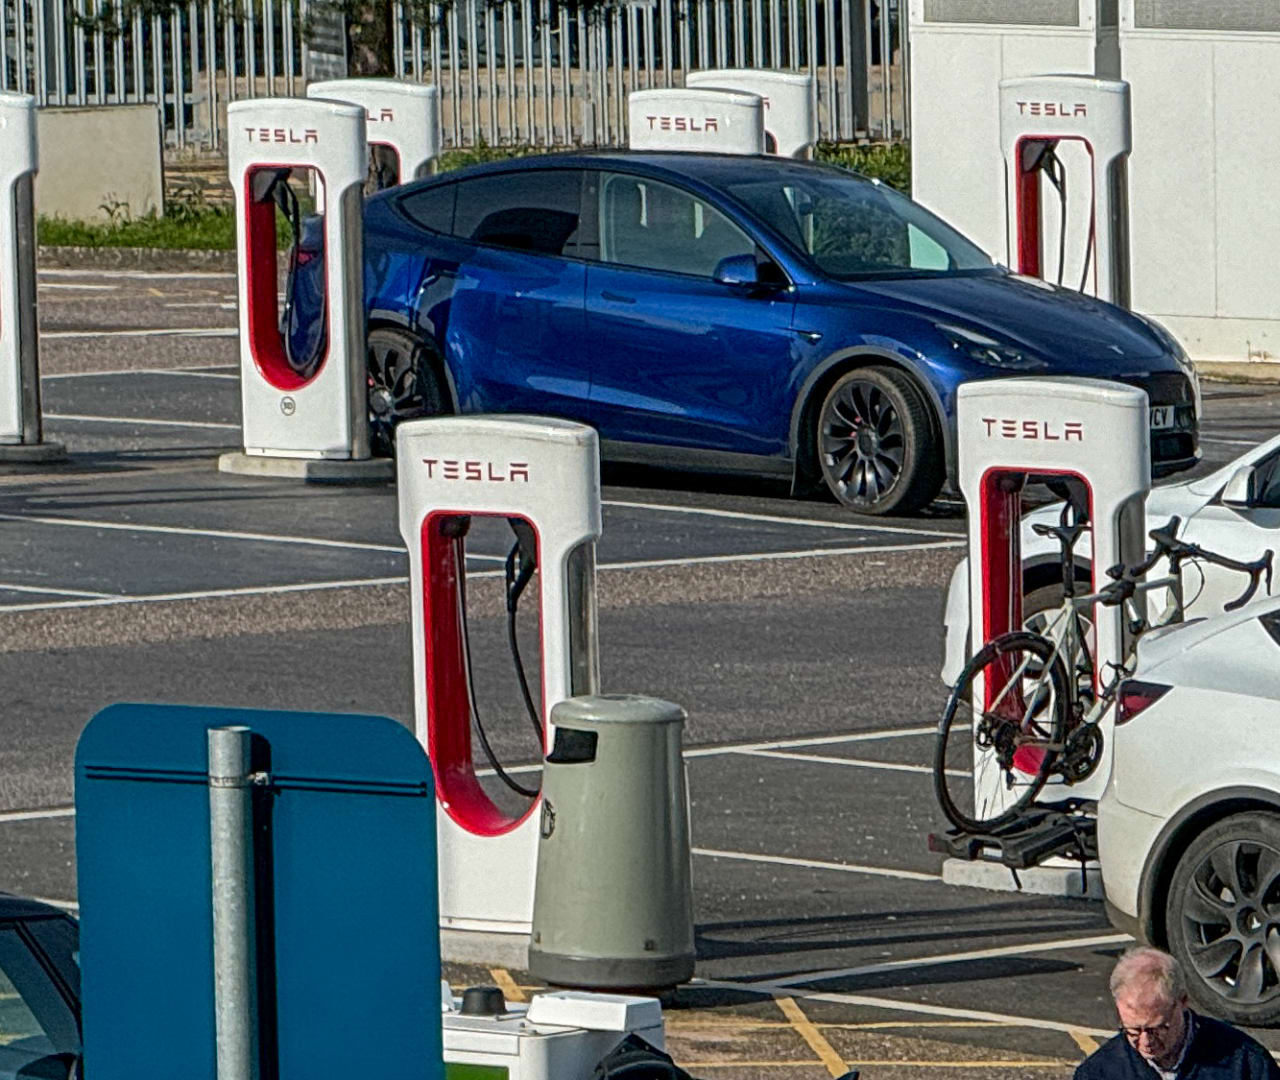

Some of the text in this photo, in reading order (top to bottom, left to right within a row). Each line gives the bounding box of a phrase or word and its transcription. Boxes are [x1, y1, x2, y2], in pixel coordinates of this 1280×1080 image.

[1017, 102, 1086, 117] TESLA
[647, 117, 717, 132] TESLA
[245, 128, 318, 143] TESLA
[1150, 408, 1168, 426] CV
[982, 418, 1082, 441] TESLA
[423, 459, 529, 482] TESLA
